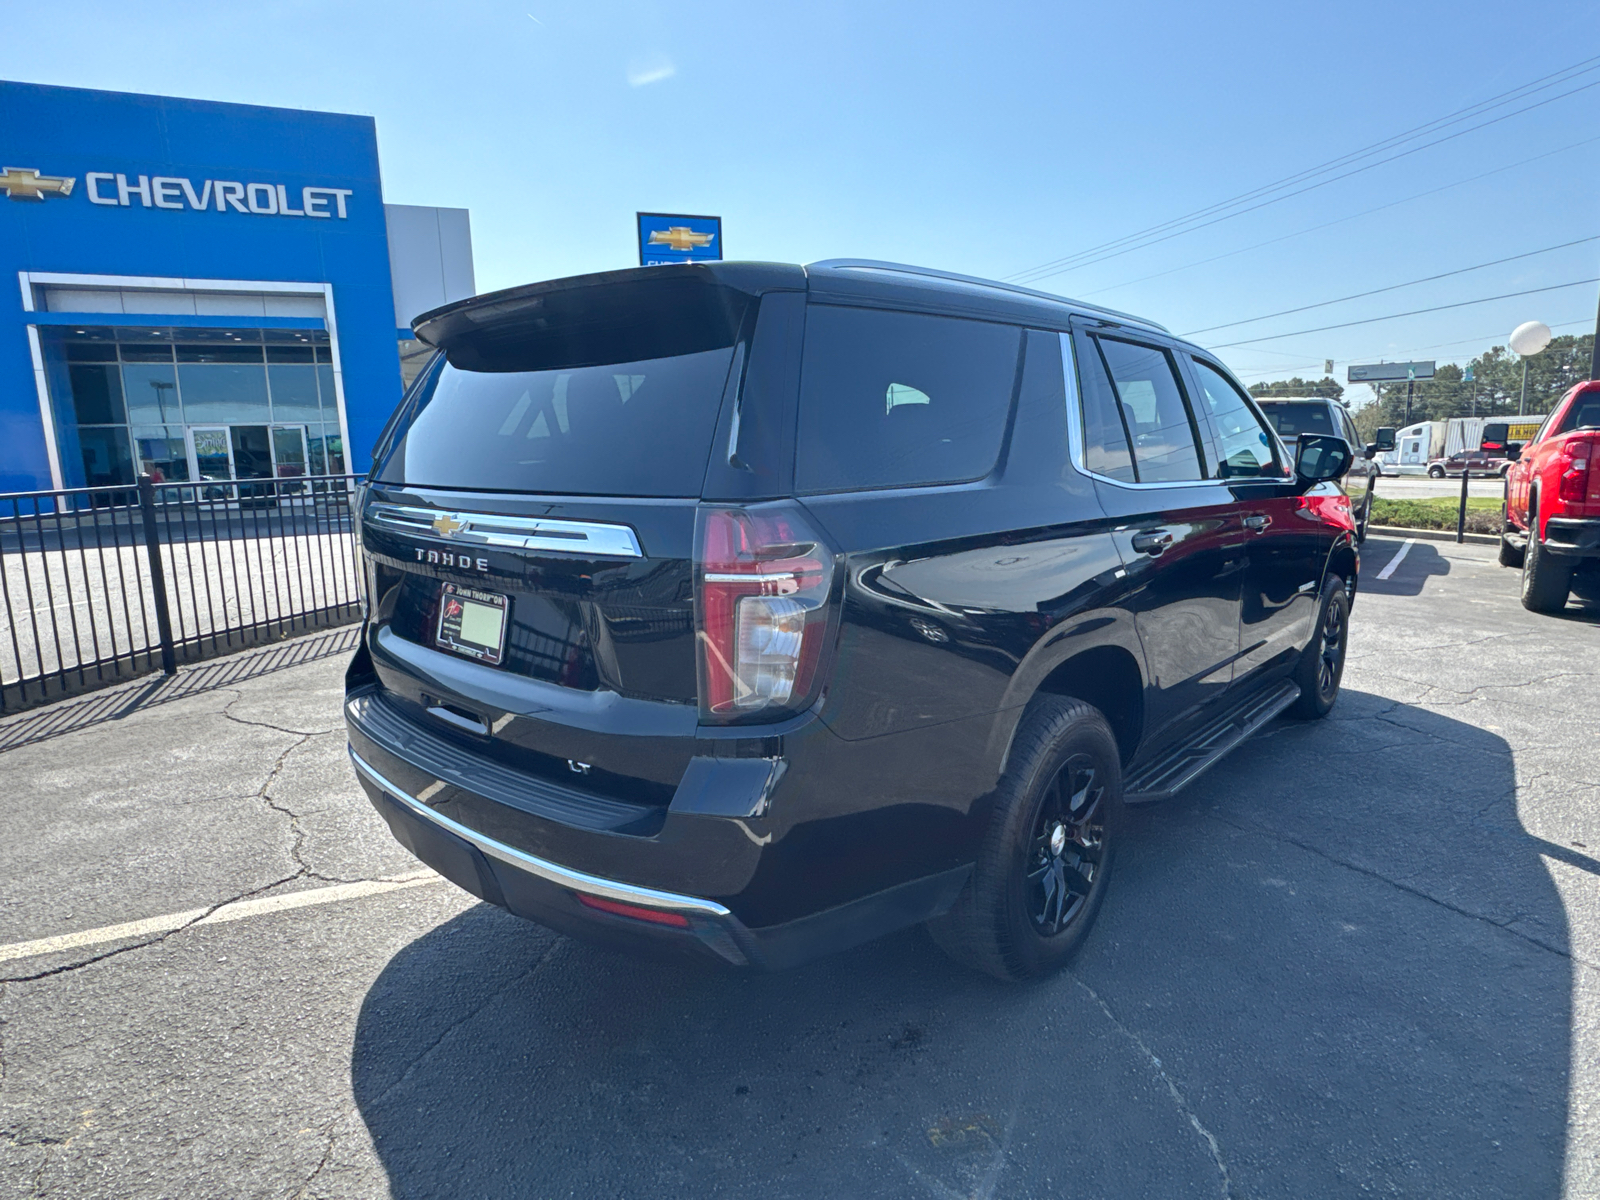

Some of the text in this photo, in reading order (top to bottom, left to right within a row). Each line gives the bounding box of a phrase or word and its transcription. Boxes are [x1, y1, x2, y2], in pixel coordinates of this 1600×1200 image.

[85, 171, 353, 219] CHEVROLET
[414, 547, 489, 572] TAHOE
[456, 586, 503, 605] JOHN THORNTON
[567, 759, 591, 775] LT
